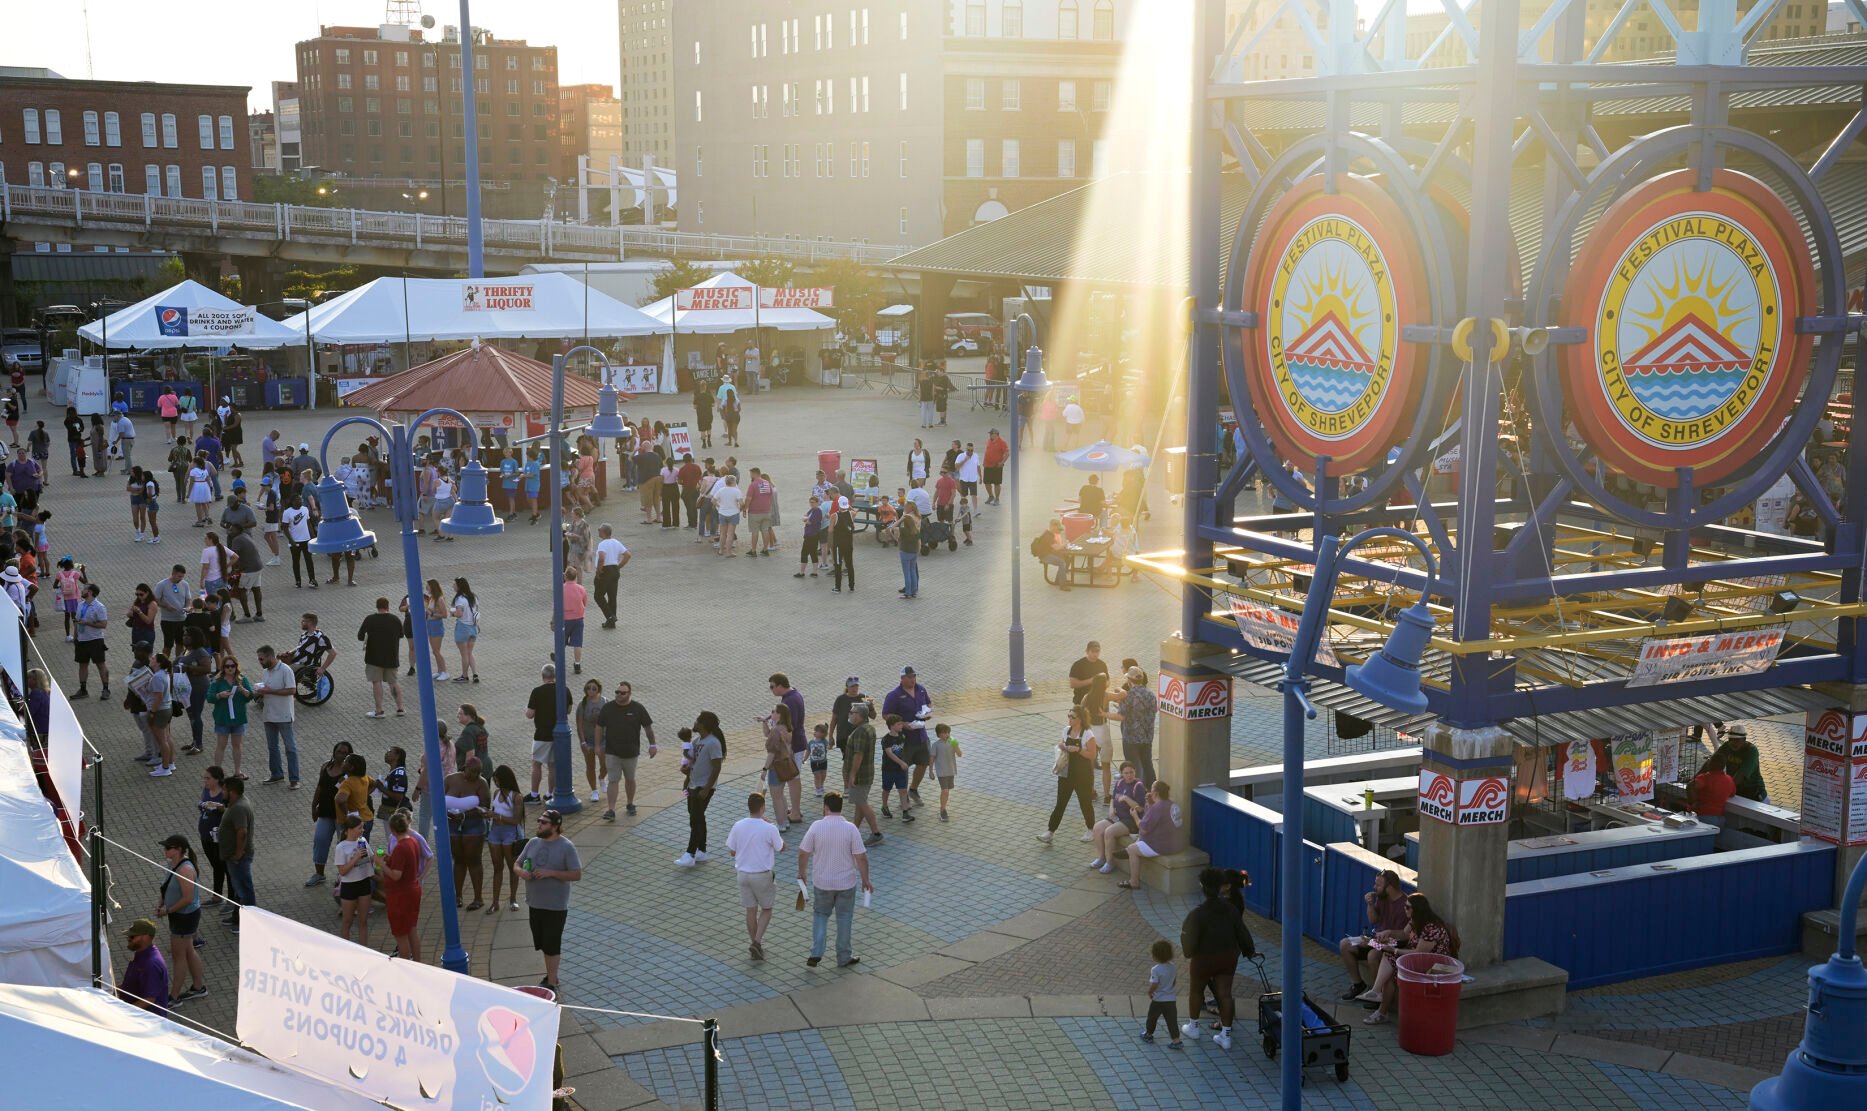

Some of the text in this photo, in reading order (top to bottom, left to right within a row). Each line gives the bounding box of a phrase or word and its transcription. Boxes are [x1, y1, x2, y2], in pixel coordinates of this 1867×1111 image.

[1282, 221, 1384, 284] FESTIVAL PLAZA
[1619, 219, 1765, 281] FESTIVAL PLAZA
[483, 286, 534, 297] THRIFTY
[693, 288, 739, 299] MUSIC
[775, 287, 820, 297] MUSIC
[486, 298, 531, 310] LIQUOR
[691, 298, 738, 309] MERCH
[773, 297, 819, 307] MERCH
[1271, 335, 1391, 432] CITY OF SHREVEPORT
[1602, 350, 1629, 402] CITY
[1629, 406, 1655, 430] OF
[1660, 342, 1772, 440] SHREVEPORT
[671, 432, 690, 444] ATM
[1265, 611, 1277, 624] &
[1645, 633, 1780, 660] INFO & MERCH
[1160, 701, 1226, 719] MERCH MERCH
[1807, 734, 1844, 755] MERCH
[1420, 801, 1505, 823] MERCH MERCH
